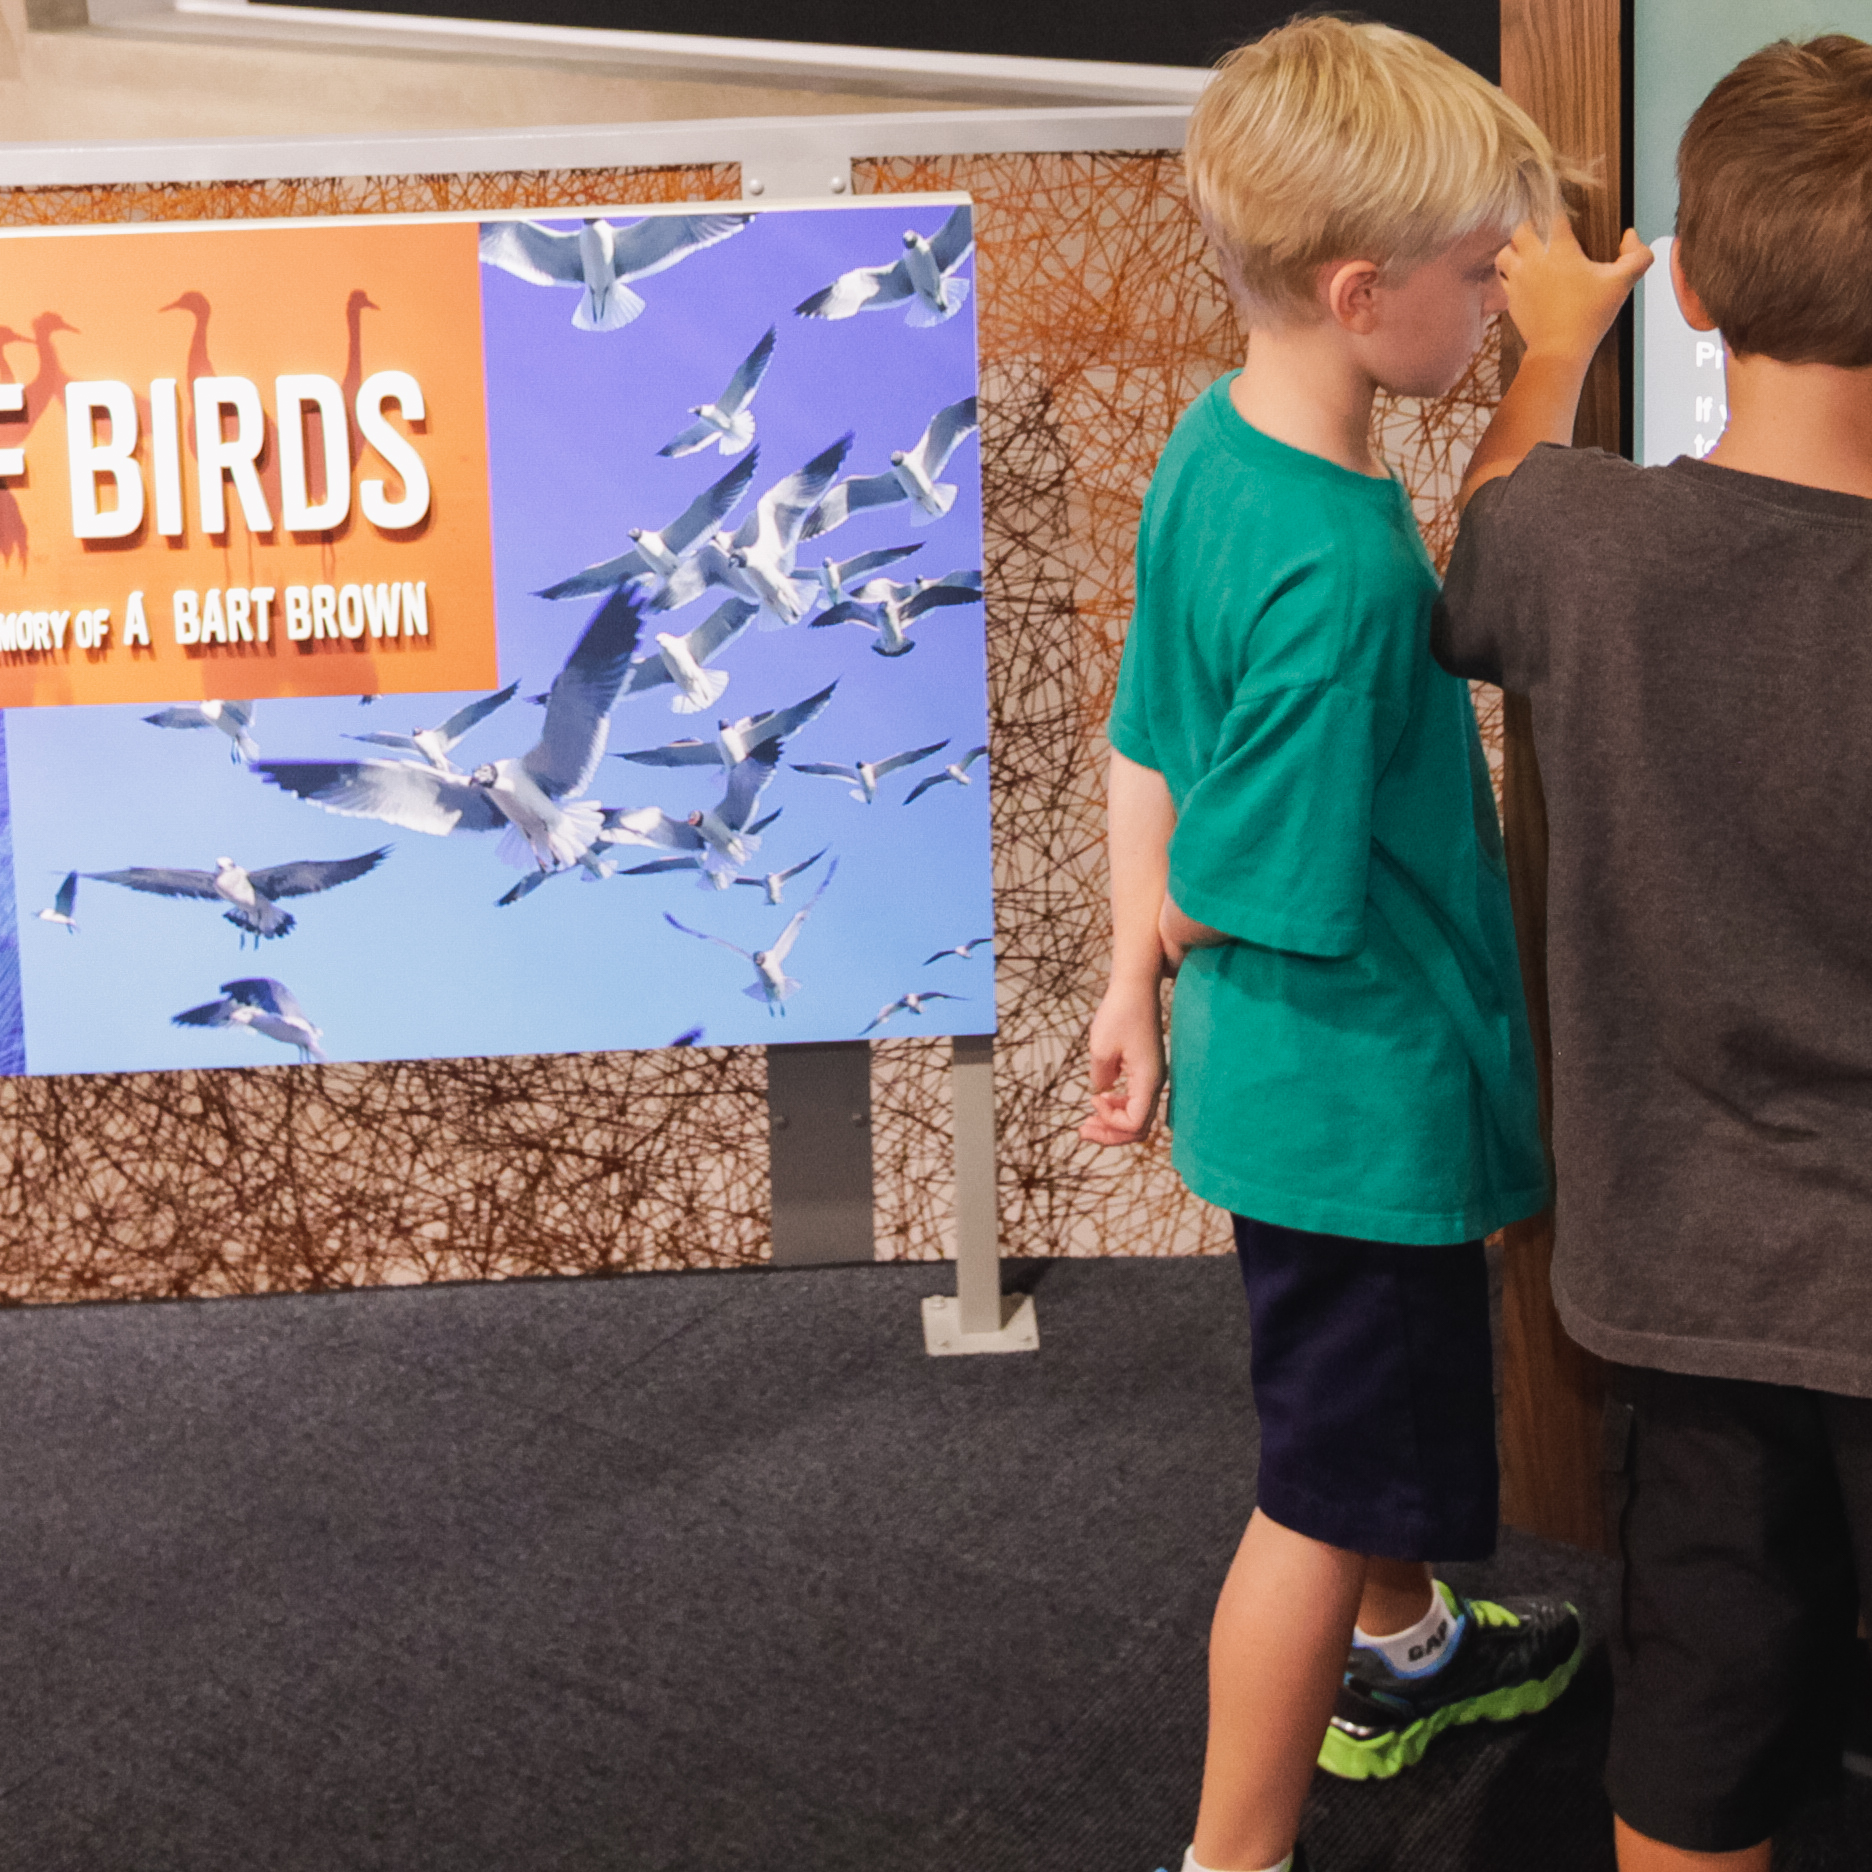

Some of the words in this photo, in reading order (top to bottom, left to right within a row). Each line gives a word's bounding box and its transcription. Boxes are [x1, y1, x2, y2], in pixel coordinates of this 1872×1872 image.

[64, 369, 431, 540] BIRDS
[74, 608, 111, 649] OF
[122, 590, 151, 646] A
[172, 586, 276, 645] BART
[284, 580, 429, 641] BROWN
[1407, 1618, 1448, 1662] GAP
